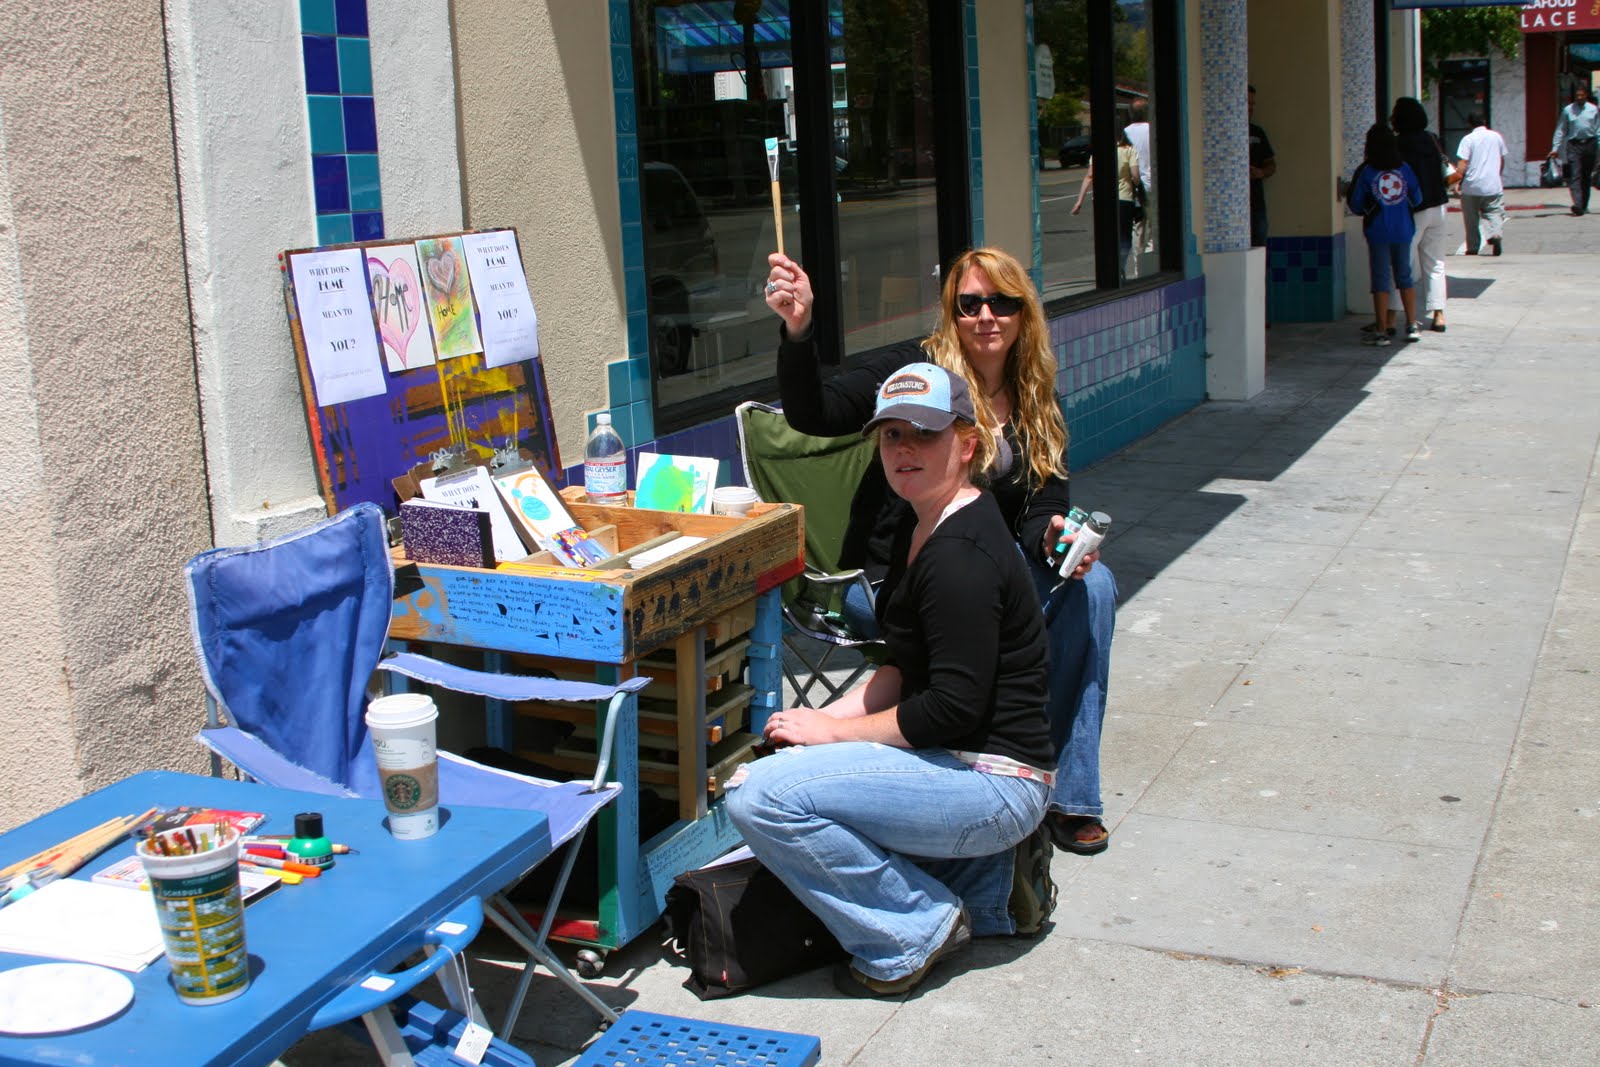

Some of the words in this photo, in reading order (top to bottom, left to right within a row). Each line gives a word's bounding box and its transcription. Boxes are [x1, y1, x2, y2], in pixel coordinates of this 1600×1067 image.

[1521, 0, 1577, 10] AFOOD
[476, 246, 493, 254] WHAT
[494, 245, 510, 253] DOES
[485, 256, 507, 267] HOME
[309, 267, 329, 276] WHAT
[330, 265, 350, 274] DOES
[318, 279, 345, 291] HOME
[489, 283, 506, 292] MEAN
[322, 309, 342, 319] MEAN
[343, 308, 353, 316] TO
[497, 308, 518, 321] YOU?
[330, 338, 356, 352] YOU?
[441, 488, 462, 498] WHAT
[462, 484, 480, 493] DOES
